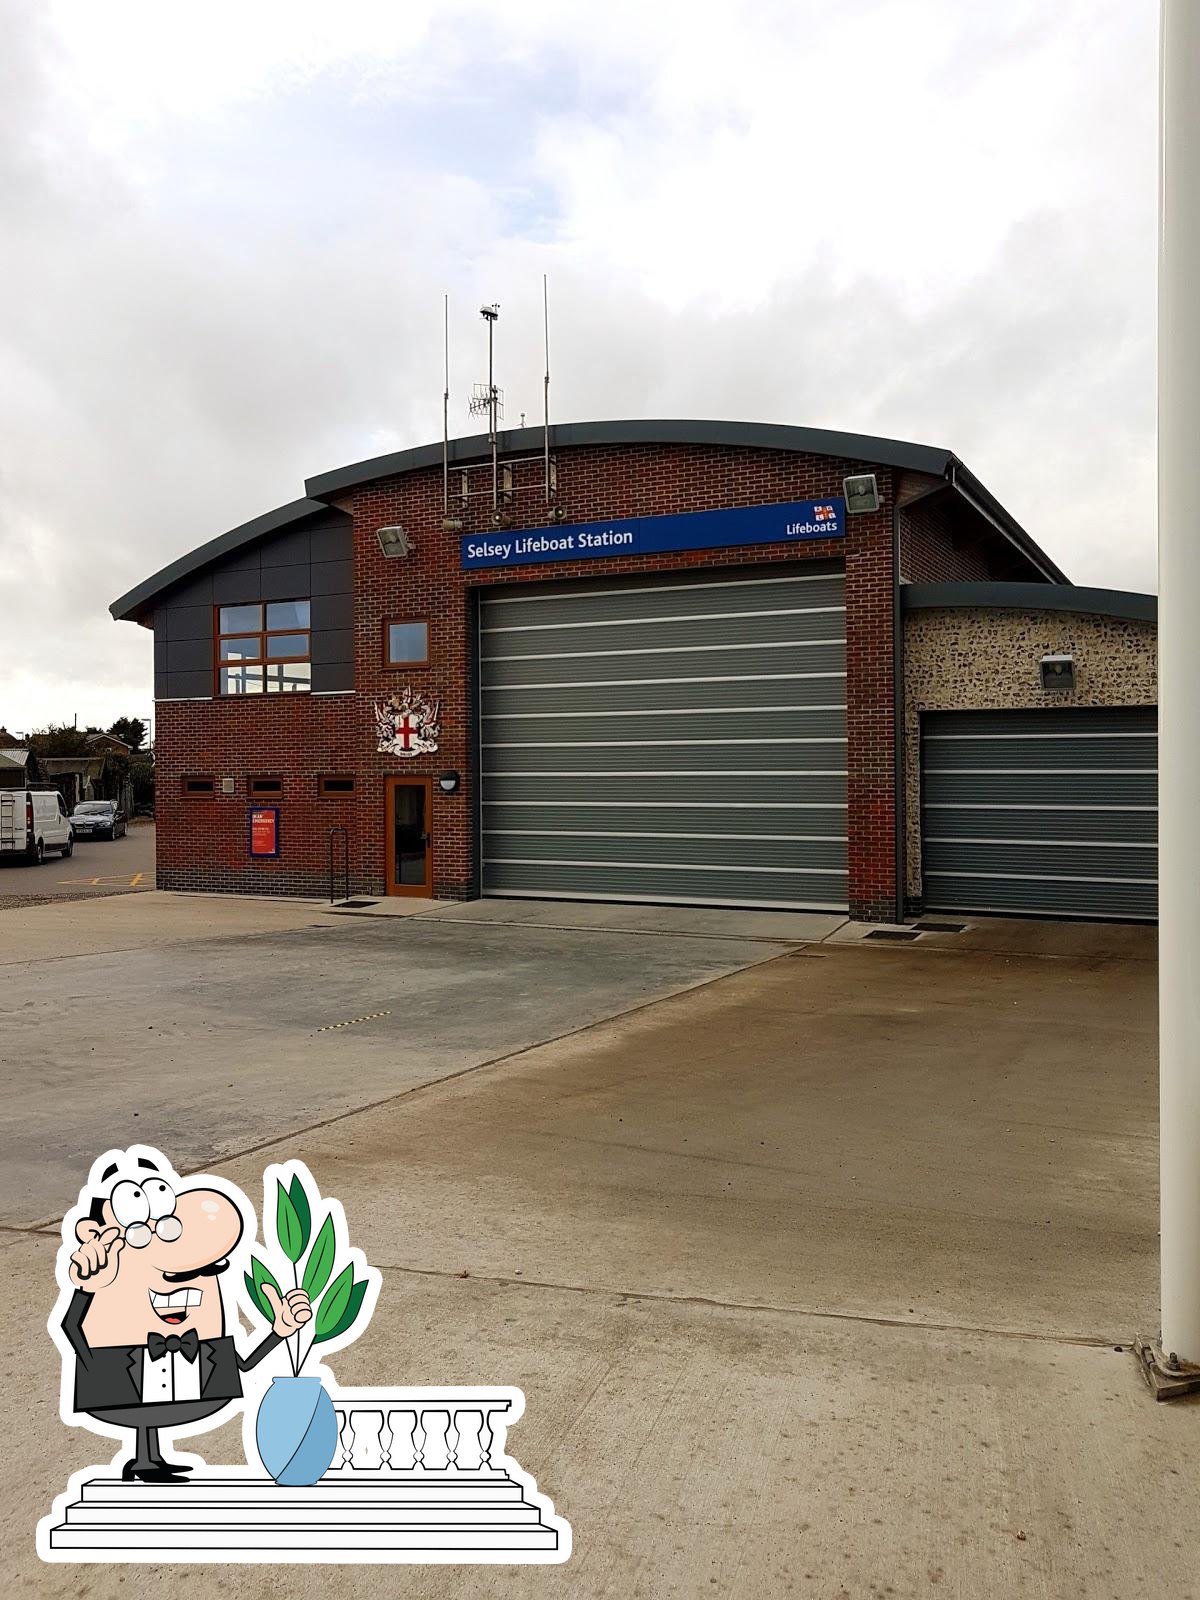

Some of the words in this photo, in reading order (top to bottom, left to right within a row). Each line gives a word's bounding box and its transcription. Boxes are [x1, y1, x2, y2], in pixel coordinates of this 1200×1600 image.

[786, 521, 837, 535] Lifeboats
[467, 542, 511, 559] Selsey
[515, 536, 575, 554] Lifeboat
[578, 530, 633, 548] Station
